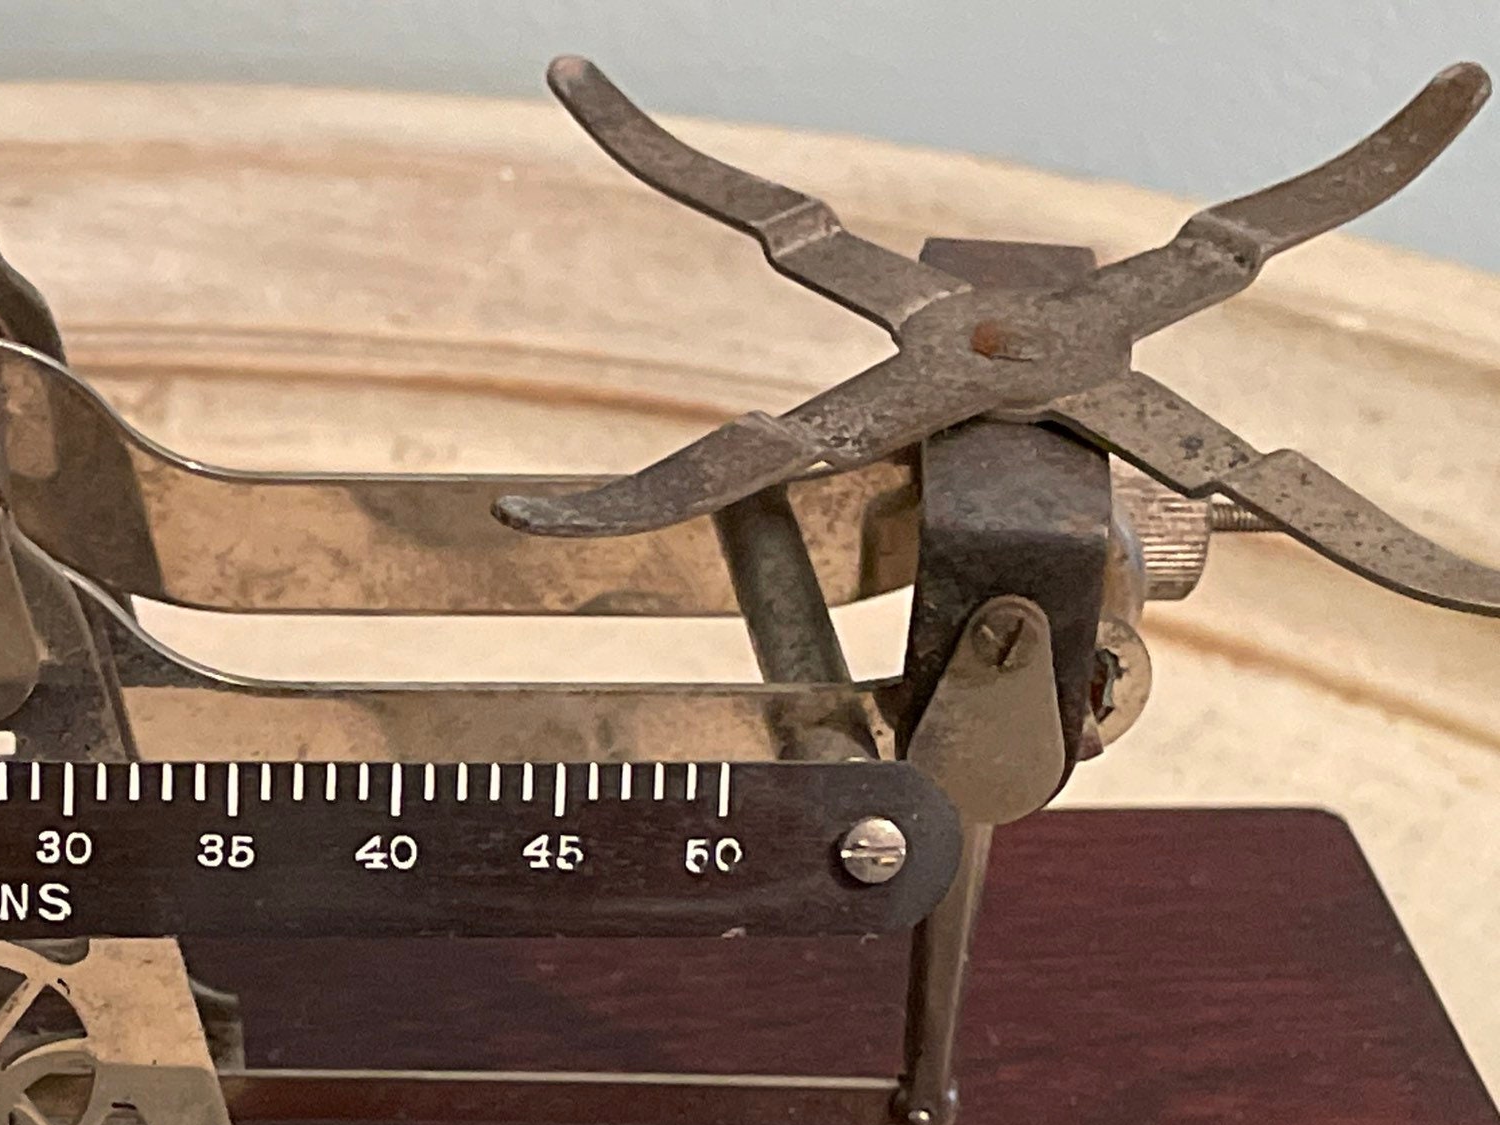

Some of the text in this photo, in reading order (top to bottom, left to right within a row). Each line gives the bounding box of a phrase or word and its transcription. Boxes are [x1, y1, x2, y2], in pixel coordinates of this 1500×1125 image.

[35, 830, 92, 865] 30
[197, 833, 255, 868] 35
[355, 834, 418, 870] 40
[522, 834, 584, 870] 45
[685, 837, 743, 874] 50
